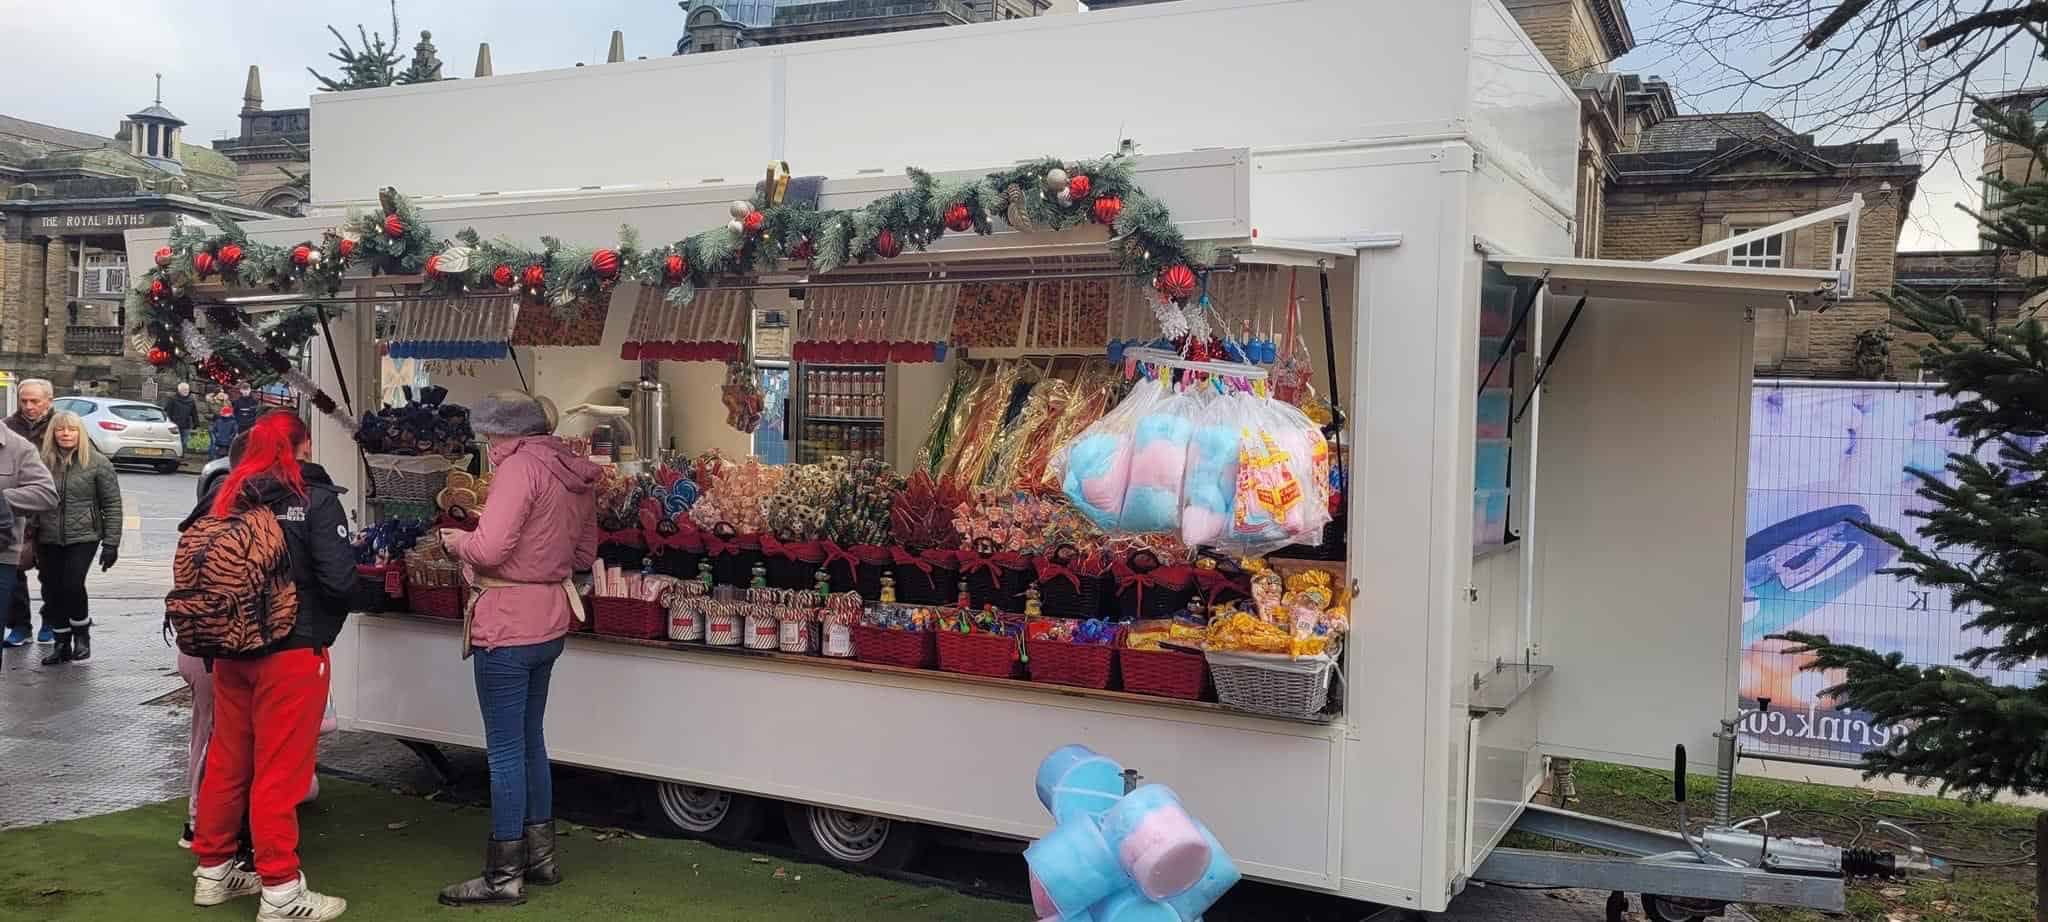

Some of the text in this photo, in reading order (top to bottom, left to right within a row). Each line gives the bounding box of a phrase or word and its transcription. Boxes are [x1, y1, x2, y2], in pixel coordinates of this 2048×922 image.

[41, 214, 145, 227] THE ROYAL BATHS
